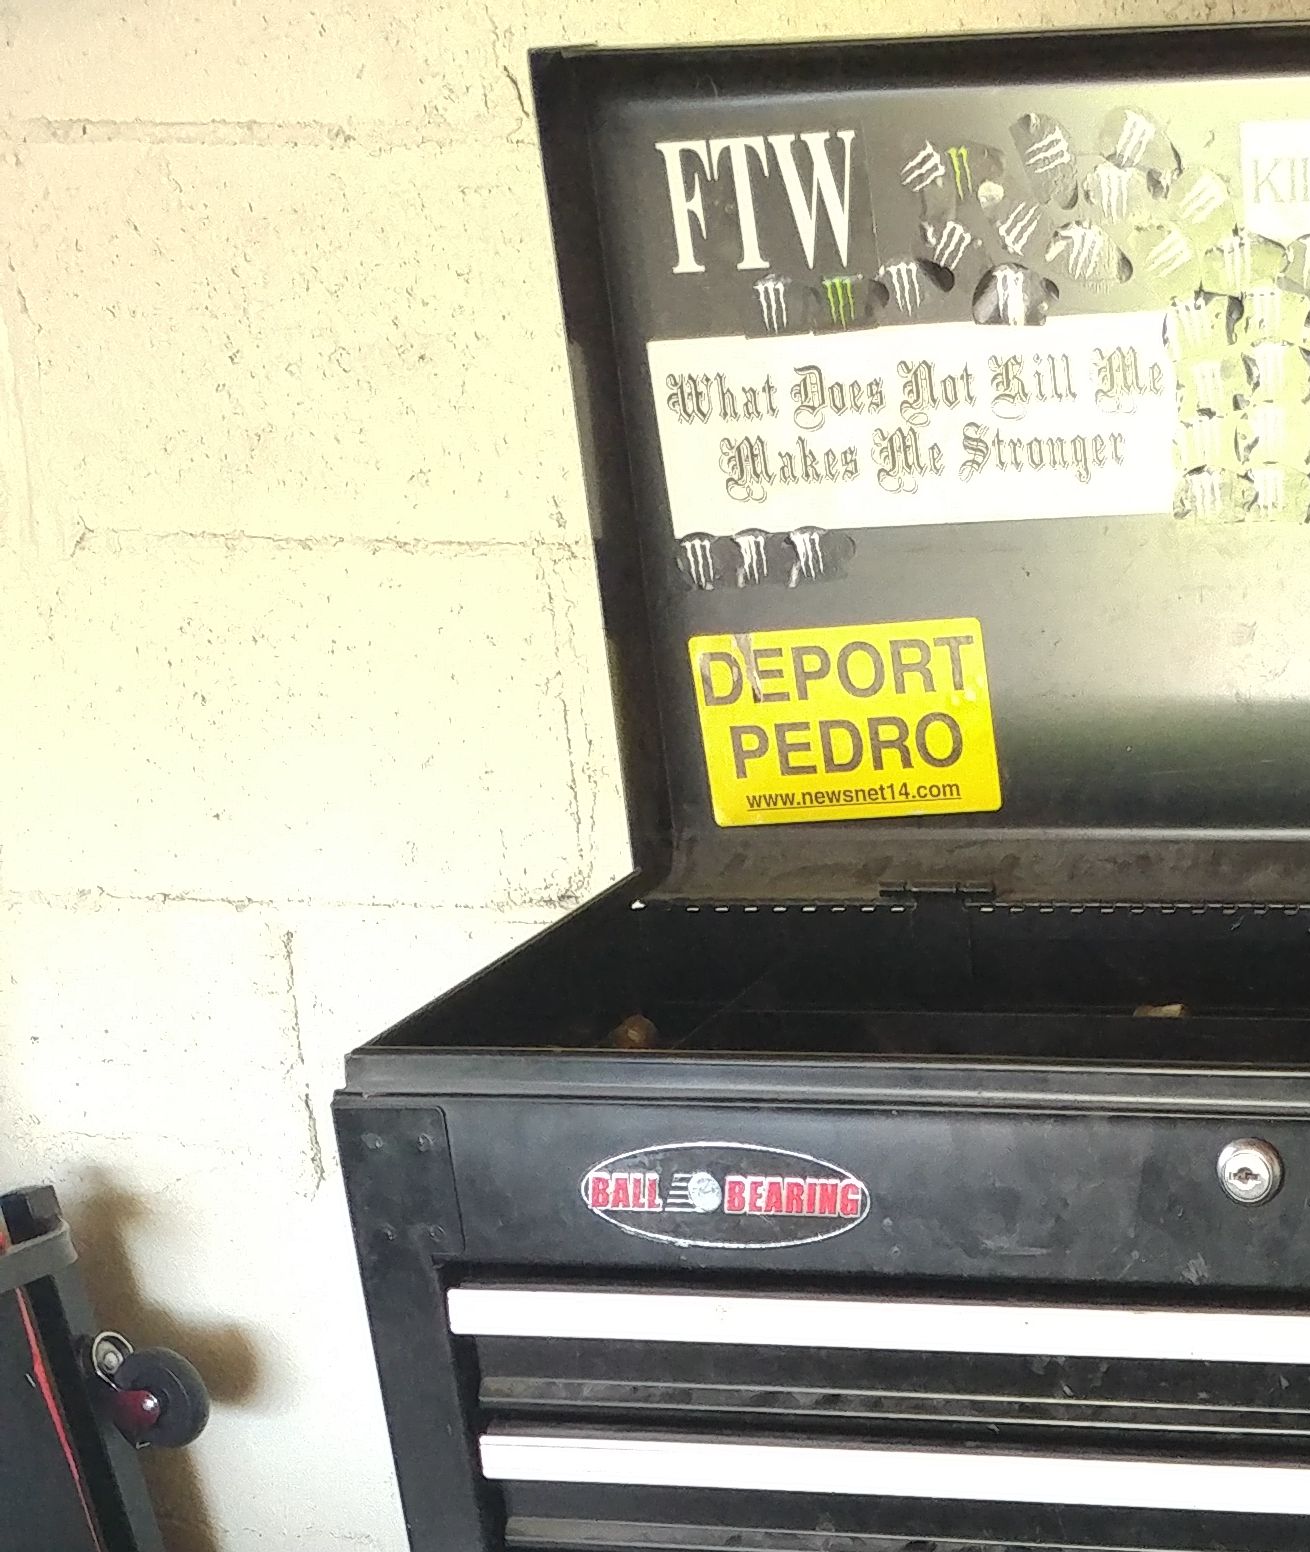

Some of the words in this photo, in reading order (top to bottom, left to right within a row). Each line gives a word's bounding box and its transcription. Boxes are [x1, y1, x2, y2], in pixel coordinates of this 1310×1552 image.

[656, 129, 857, 274] FTW
[666, 371, 779, 425] What
[790, 364, 886, 431] Does
[896, 359, 977, 427] Not
[987, 352, 1077, 421] Kill
[1090, 345, 1165, 414] Me
[719, 434, 860, 503] Makes
[871, 425, 945, 494] Me
[958, 421, 1126, 484] Stronger
[696, 634, 976, 709] DEPORT
[730, 711, 965, 779] PEDRO
[745, 781, 963, 811] www.newsnet14.com
[589, 1171, 662, 1212] BALL
[724, 1175, 862, 1219] BEARING
